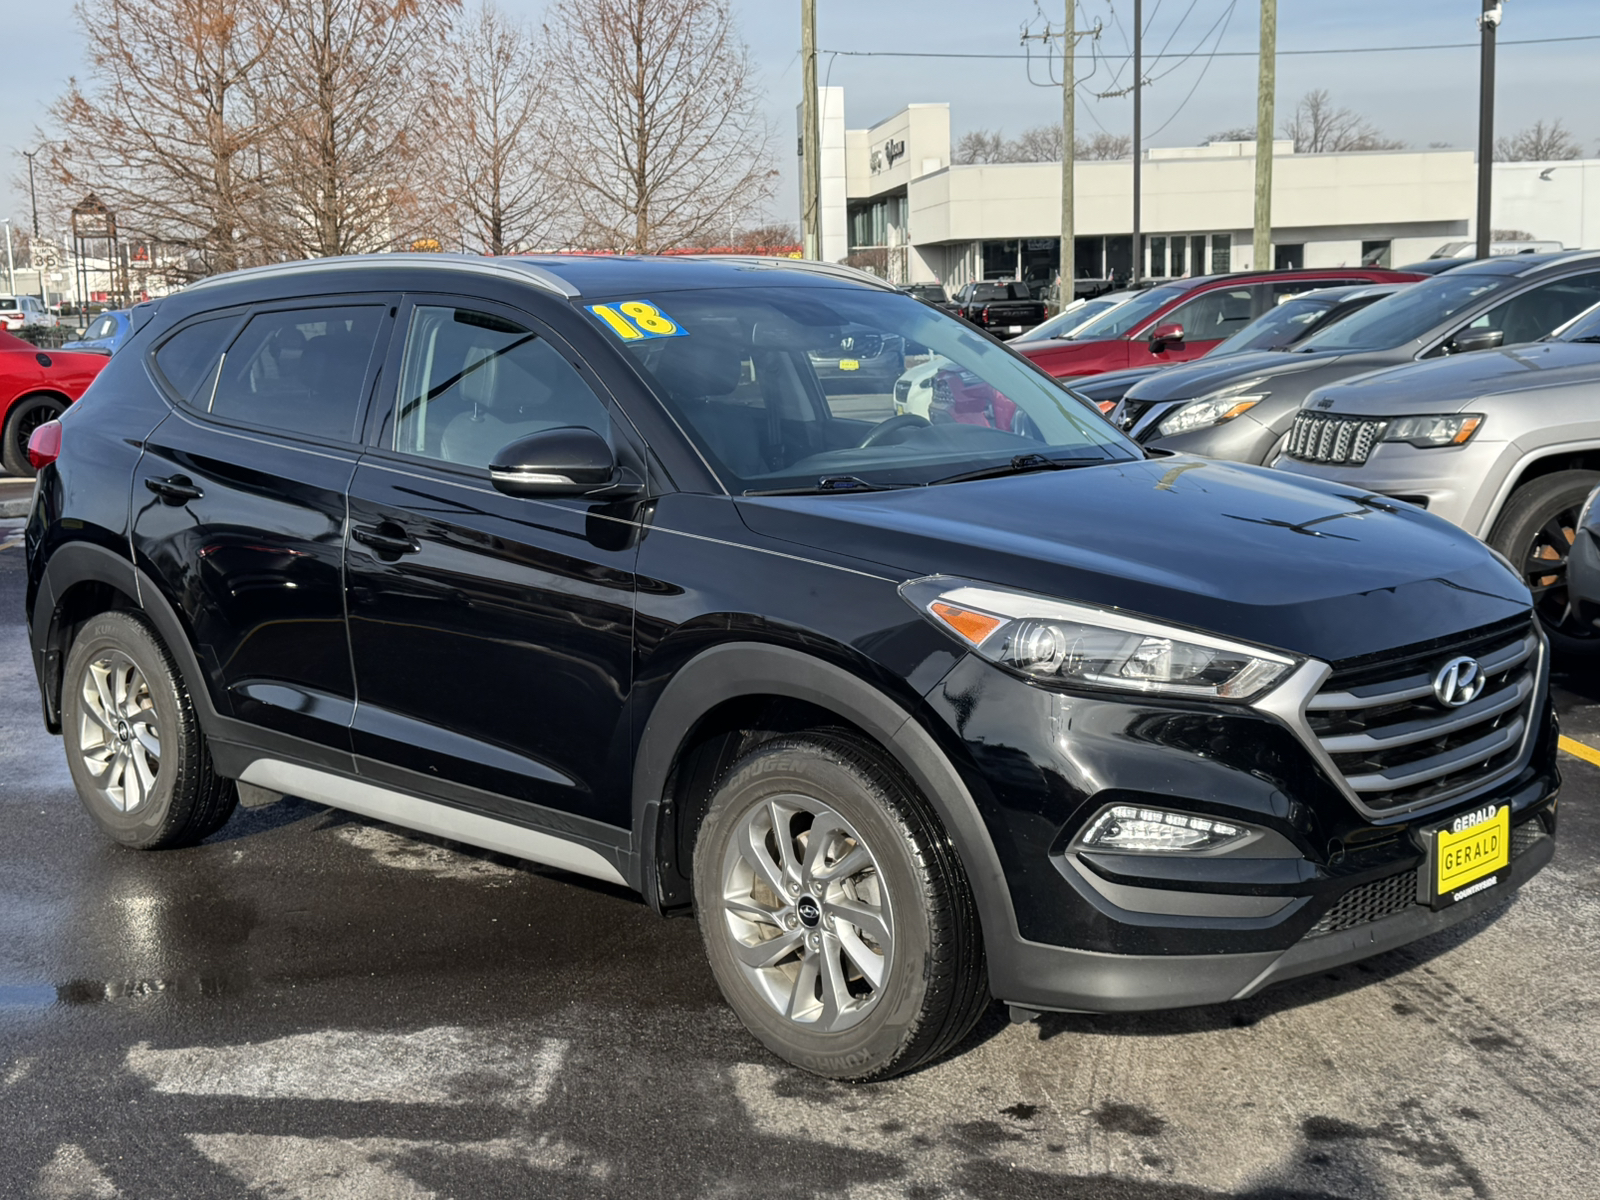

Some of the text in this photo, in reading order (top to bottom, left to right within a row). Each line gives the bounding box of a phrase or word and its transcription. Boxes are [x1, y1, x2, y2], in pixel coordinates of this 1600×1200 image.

[591, 302, 677, 339] 18
[1453, 805, 1497, 832] GERALD
[1445, 835, 1498, 870] GERALD
[802, 1047, 873, 1070] KUMHO
